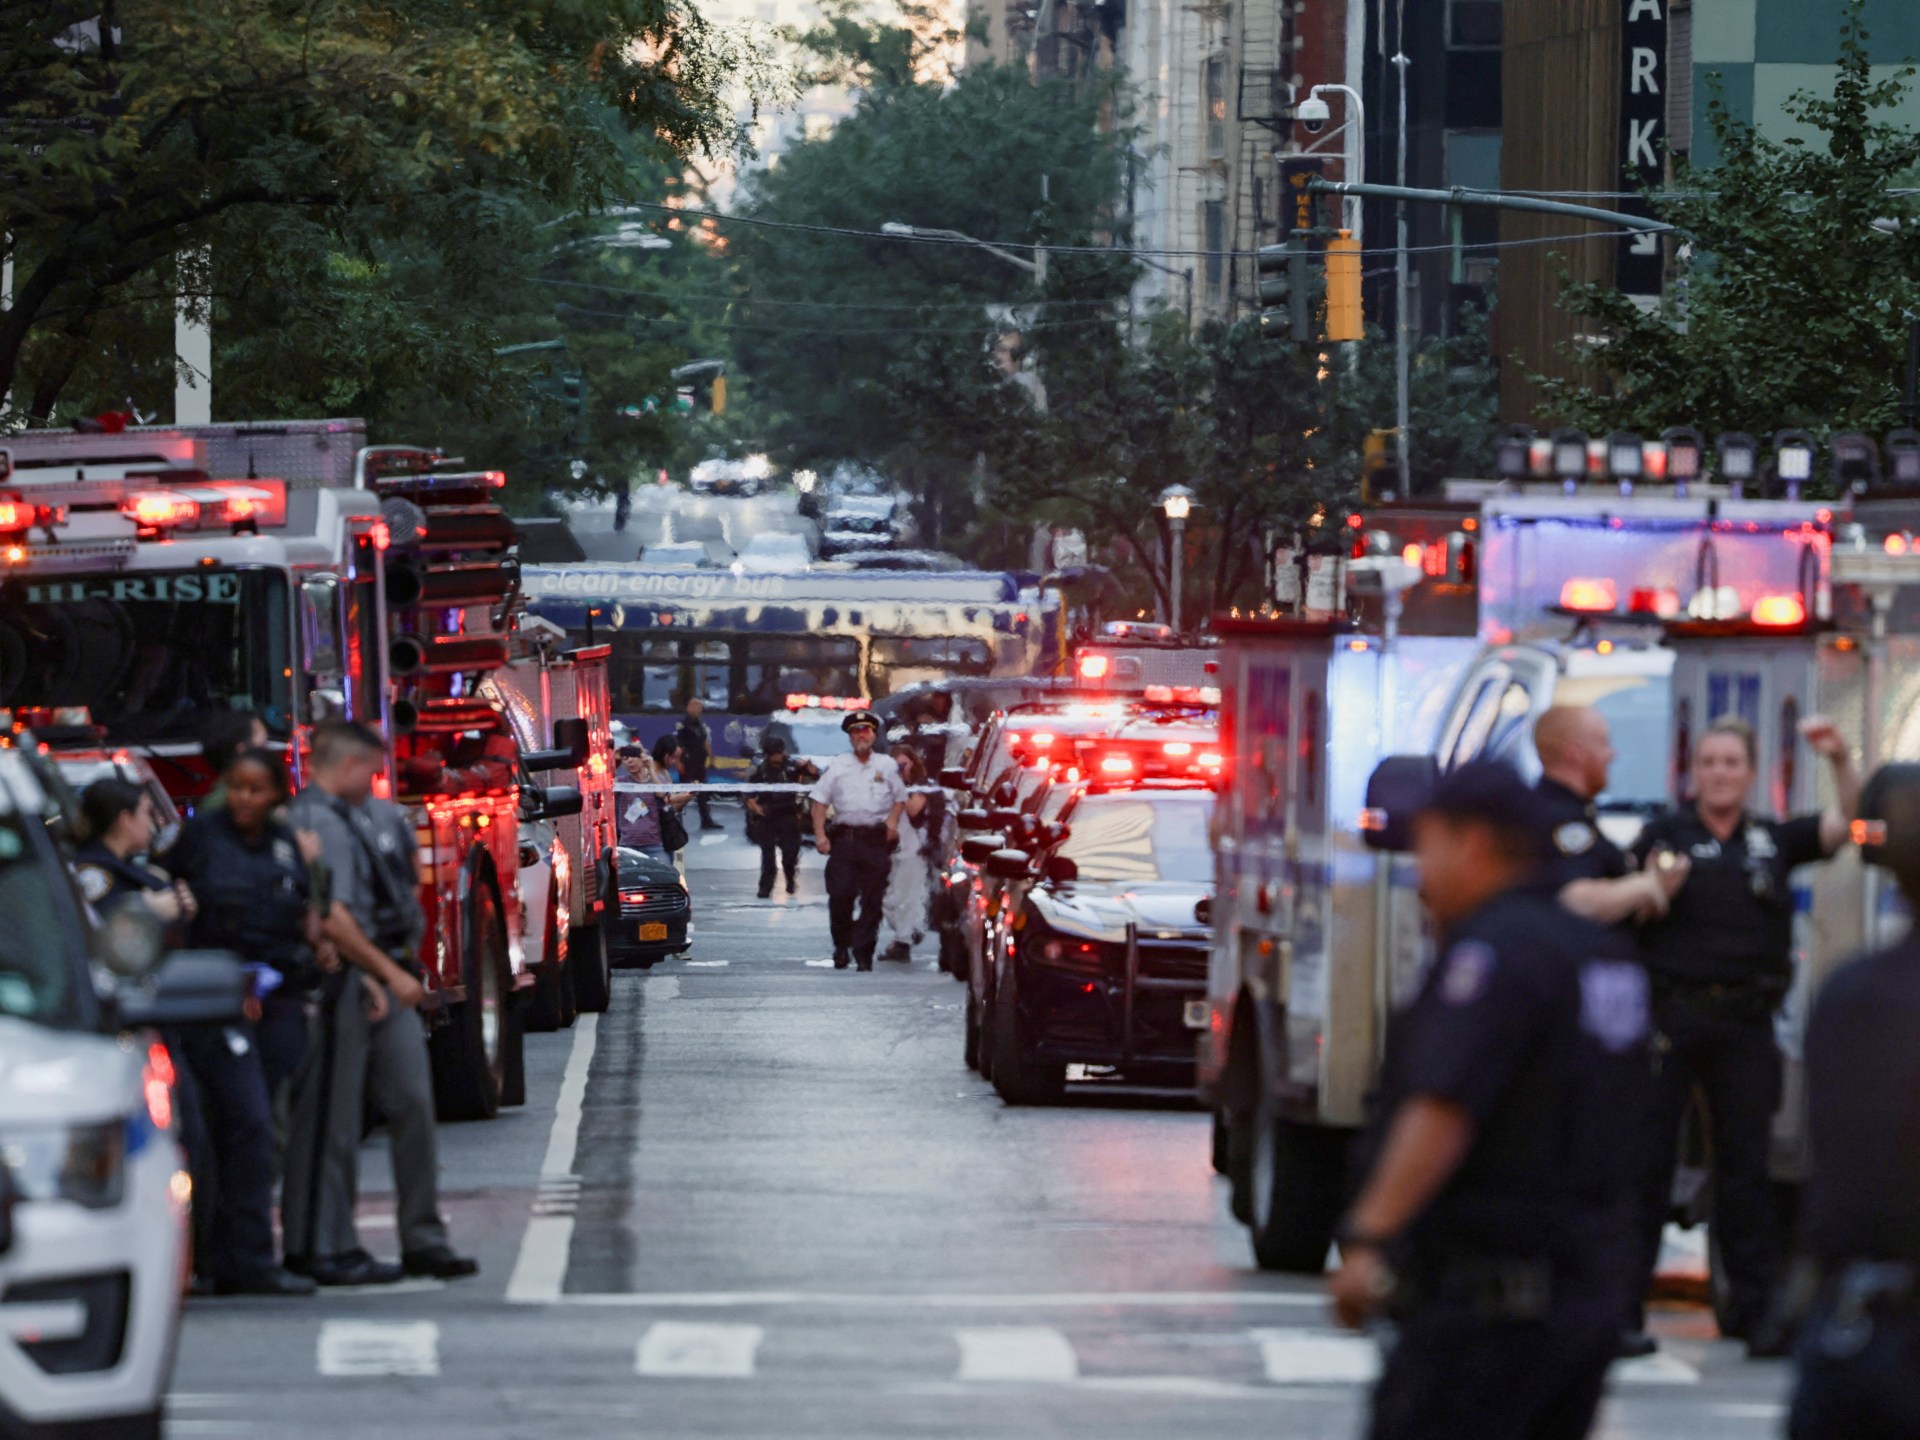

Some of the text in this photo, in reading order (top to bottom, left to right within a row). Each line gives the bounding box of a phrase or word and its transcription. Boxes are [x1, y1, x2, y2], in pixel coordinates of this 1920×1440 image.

[27, 573, 241, 604] HI-RISE
[543, 569, 785, 597] clean-energy bus
